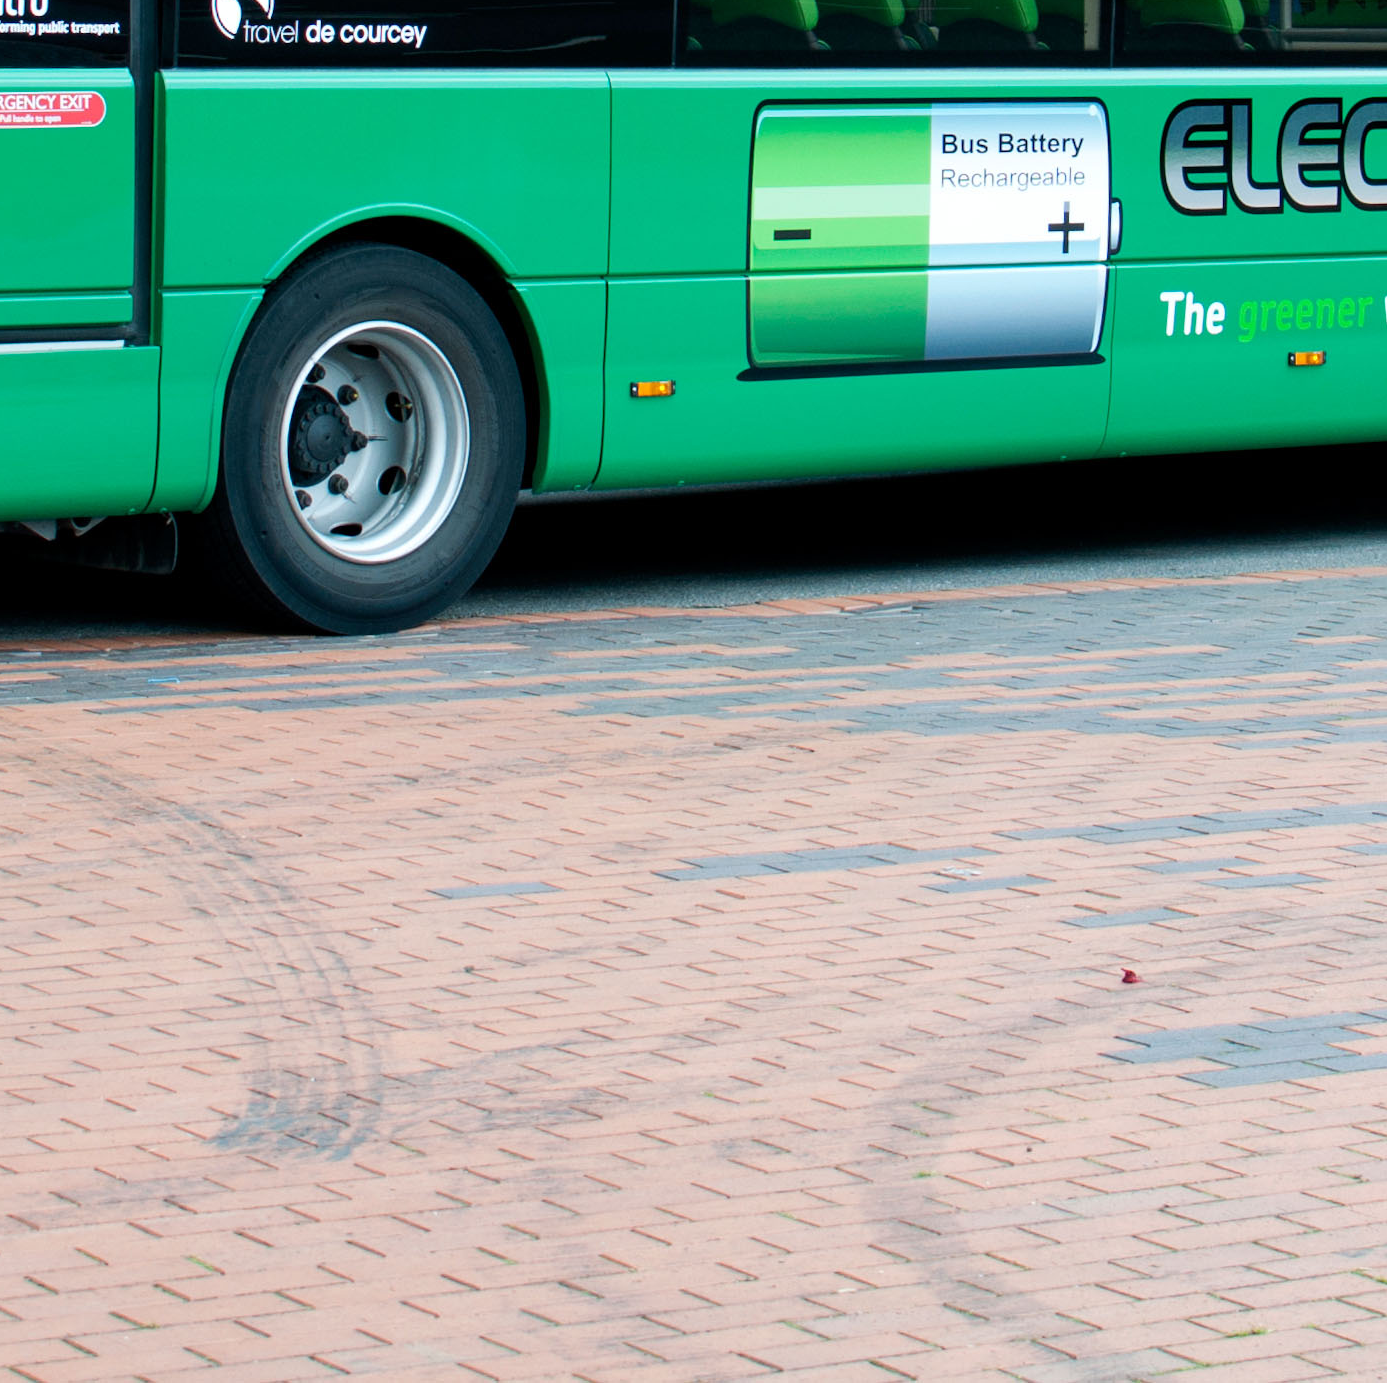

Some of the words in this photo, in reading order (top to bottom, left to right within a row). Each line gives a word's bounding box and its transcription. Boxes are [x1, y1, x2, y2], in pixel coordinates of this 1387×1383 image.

[37, 20, 69, 36] public
[71, 21, 120, 36] transport
[243, 19, 299, 43] travel
[305, 19, 335, 43] de
[340, 23, 427, 48] courcey
[60, 94, 92, 109] EXIT
[941, 133, 989, 155] Bus
[998, 133, 1084, 158] Battery
[941, 167, 1086, 191] Rechargeable
[1160, 290, 1226, 336] The
[1239, 293, 1374, 344] greener
